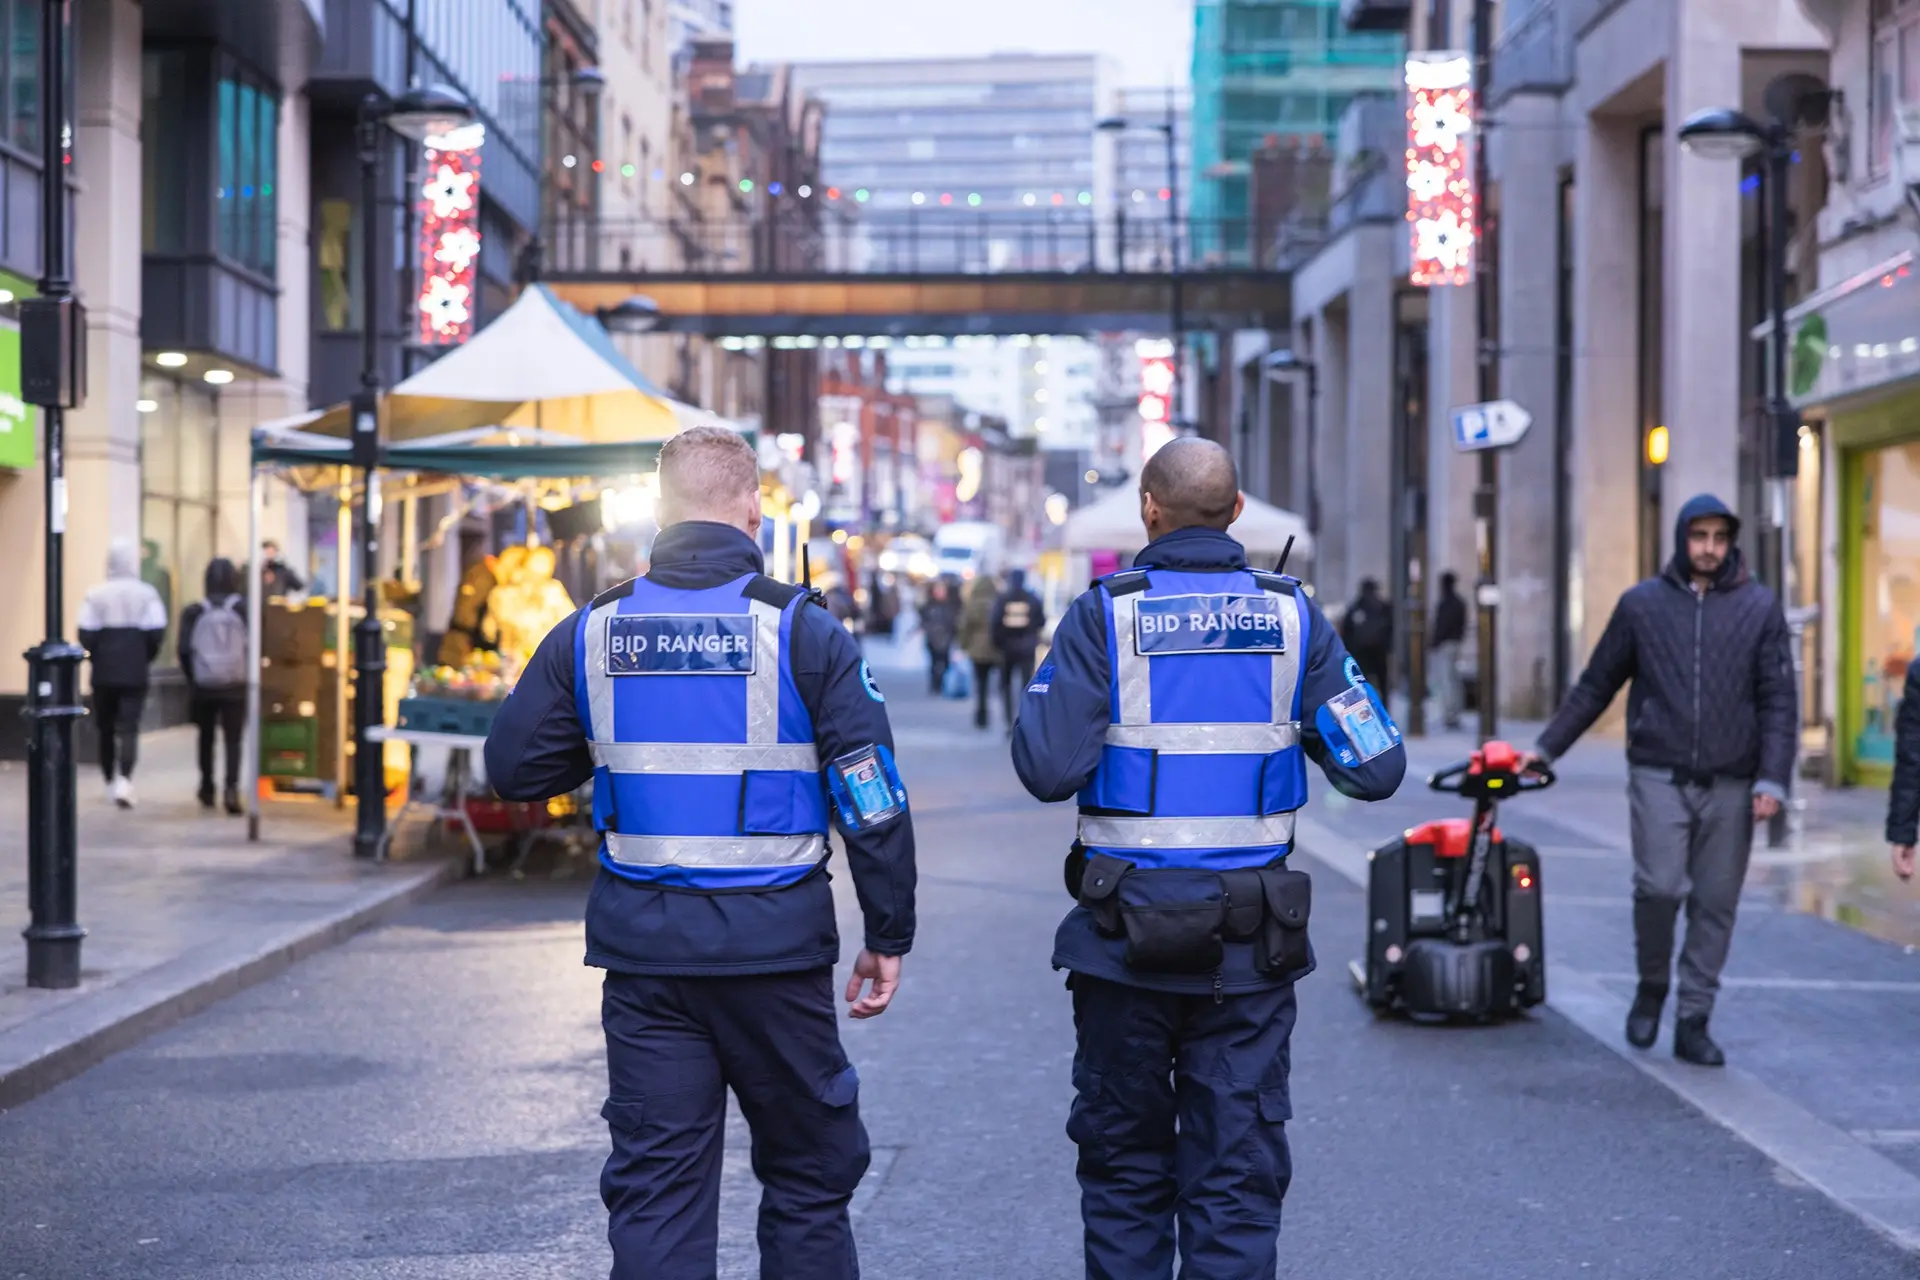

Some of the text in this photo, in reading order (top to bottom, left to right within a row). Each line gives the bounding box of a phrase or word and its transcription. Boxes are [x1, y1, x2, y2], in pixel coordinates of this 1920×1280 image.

[1462, 410, 1484, 444] P
[1141, 613, 1280, 634] BID RANGER
[611, 635, 749, 653] BID RANGER
